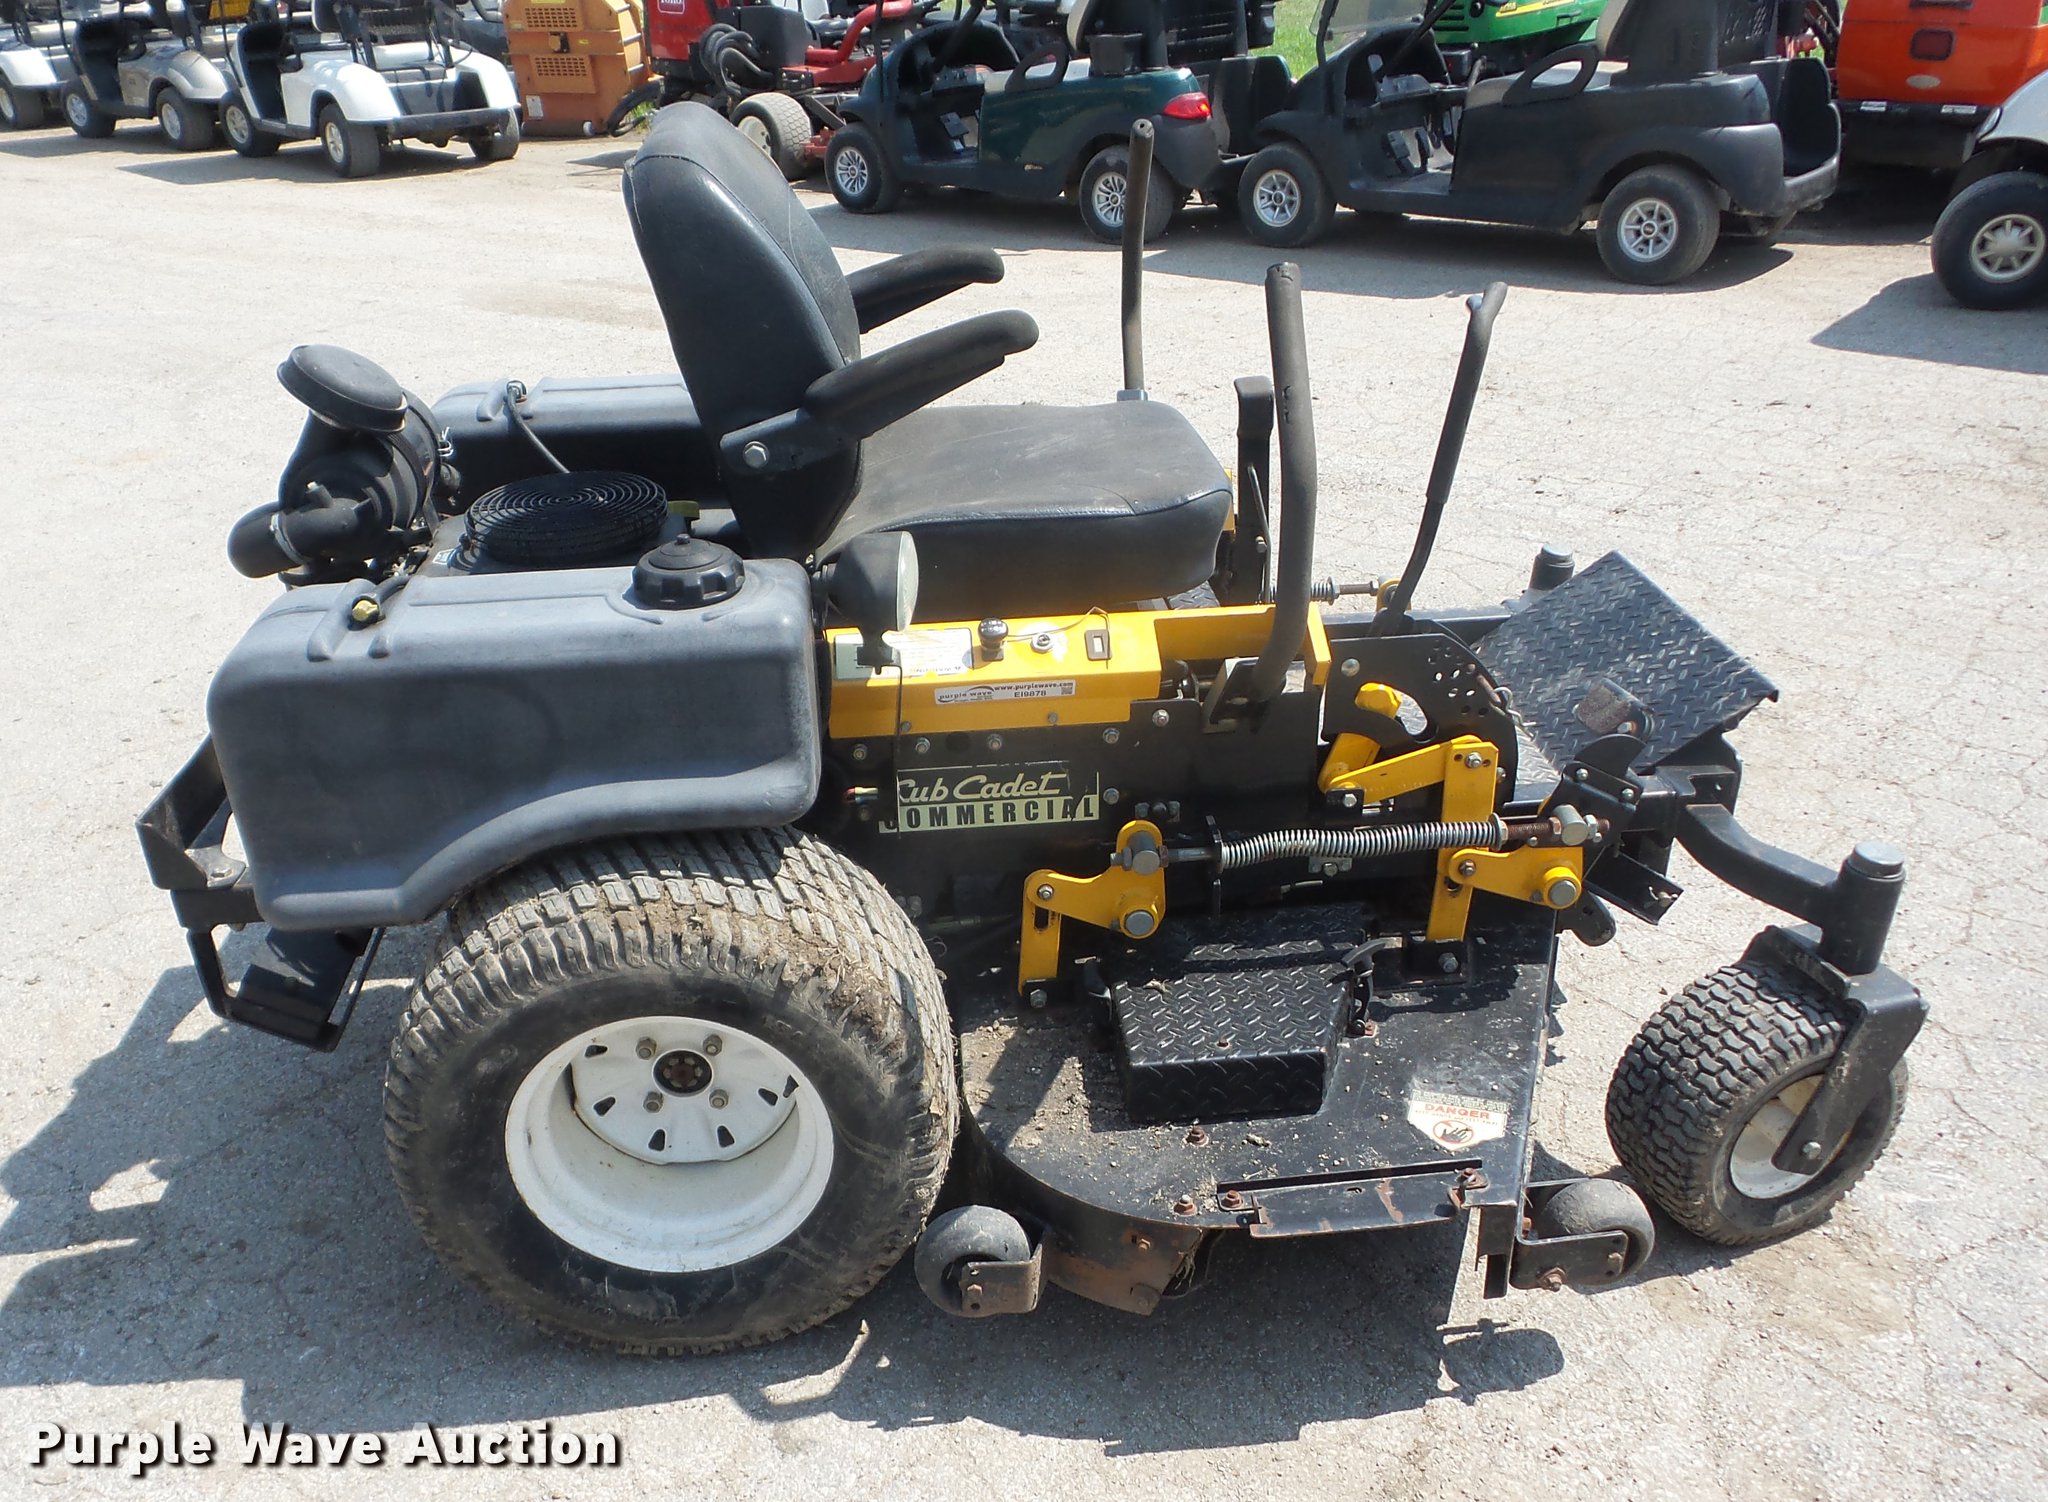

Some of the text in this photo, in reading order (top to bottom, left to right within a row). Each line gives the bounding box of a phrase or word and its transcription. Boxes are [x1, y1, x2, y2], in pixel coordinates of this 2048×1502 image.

[994, 682, 1073, 691] www.purplewave.com
[898, 772, 1068, 803] Cub Cadet
[1424, 1103, 1490, 1120] DANGER
